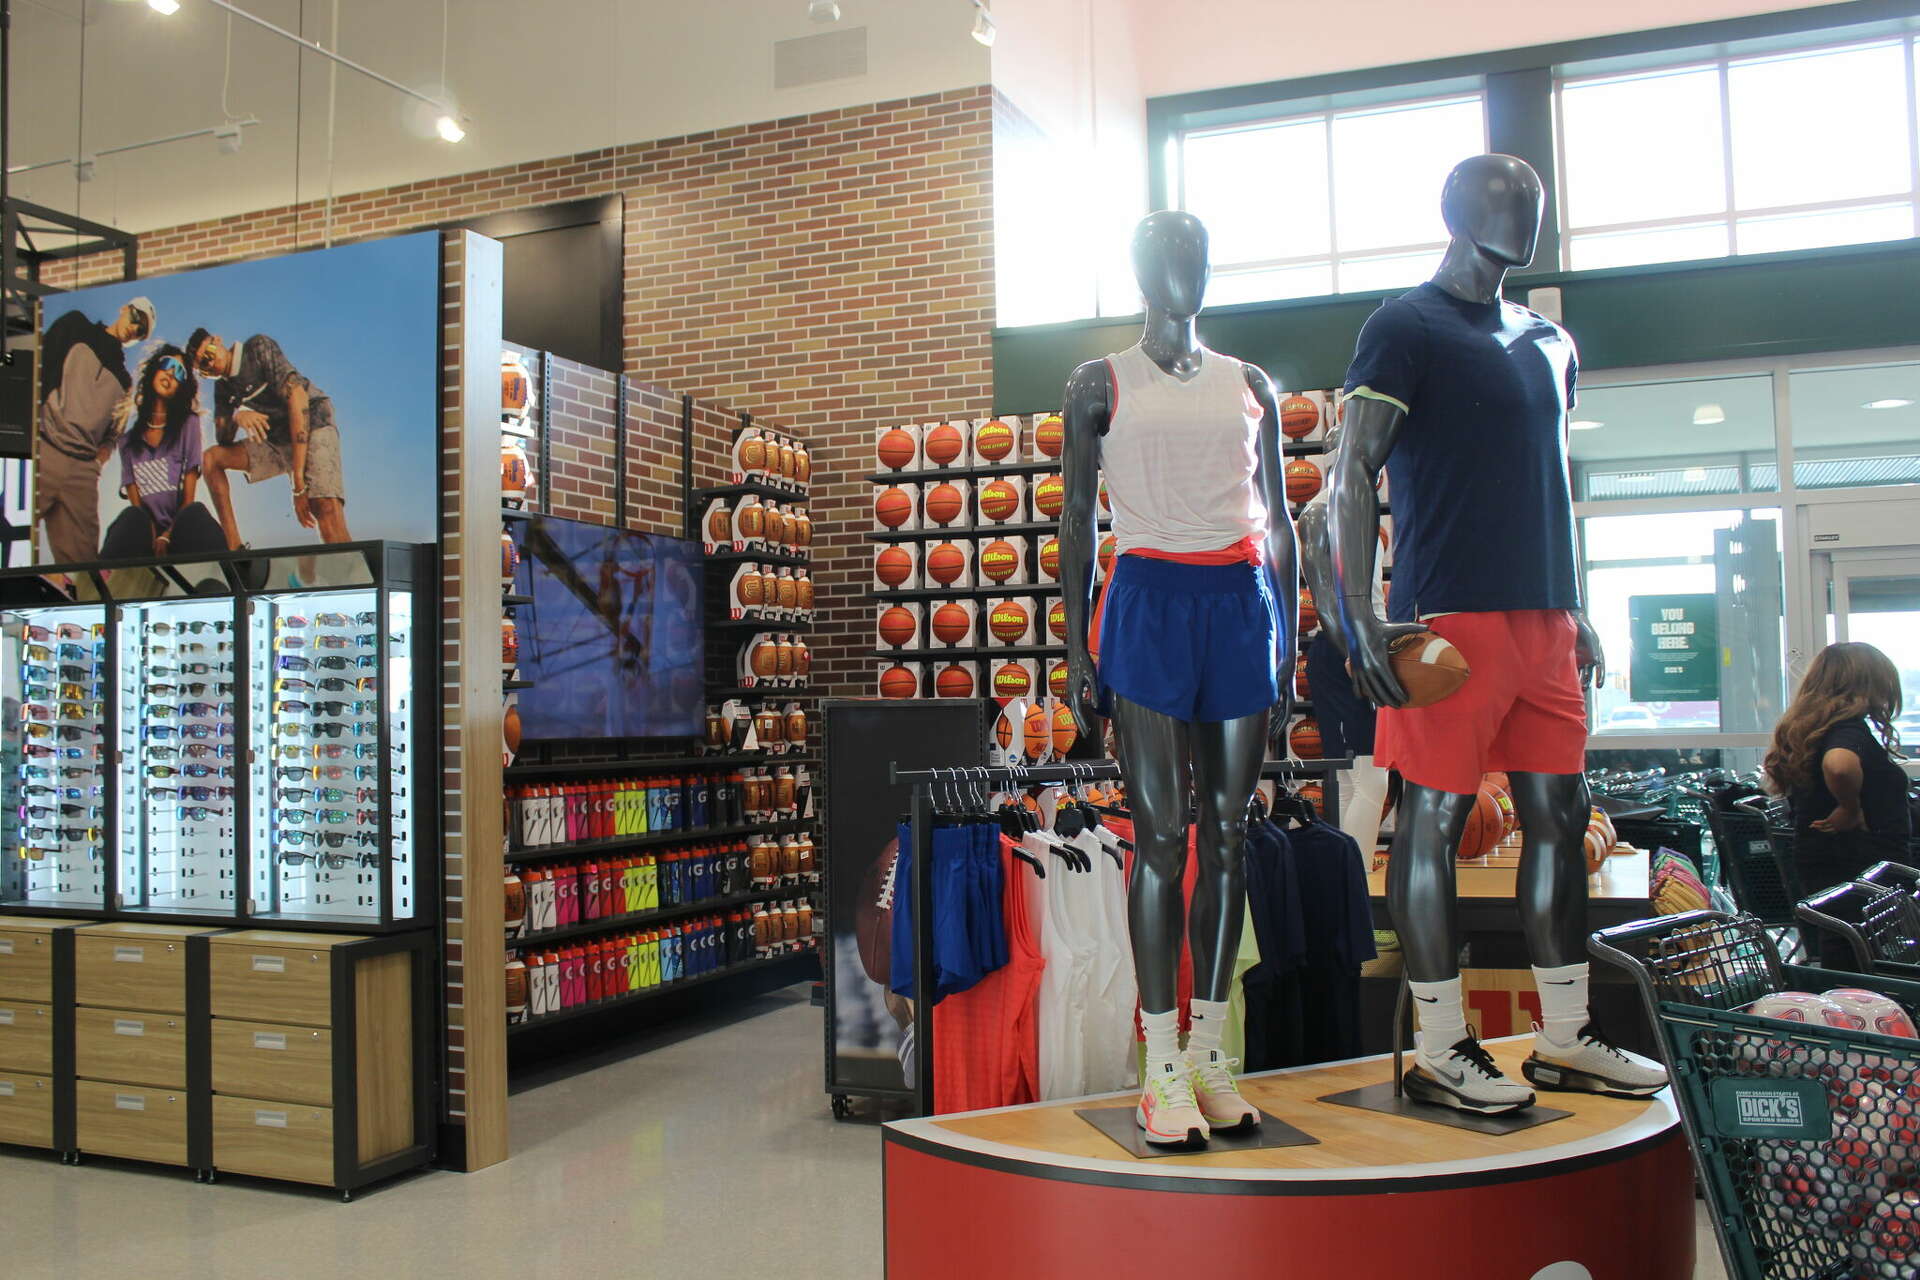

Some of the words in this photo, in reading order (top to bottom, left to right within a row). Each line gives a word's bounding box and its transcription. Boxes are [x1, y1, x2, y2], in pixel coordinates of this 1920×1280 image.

[980, 426, 1009, 437] Wilson
[1043, 543, 1058, 555] Wil
[983, 552, 1013, 563] Wilson
[992, 613, 1024, 623] Wilson
[1661, 608, 1684, 620] YOU
[1651, 622, 1695, 635] BELONG
[996, 674, 1027, 685] Wilson
[1740, 1097, 1799, 1118] DICK'S
